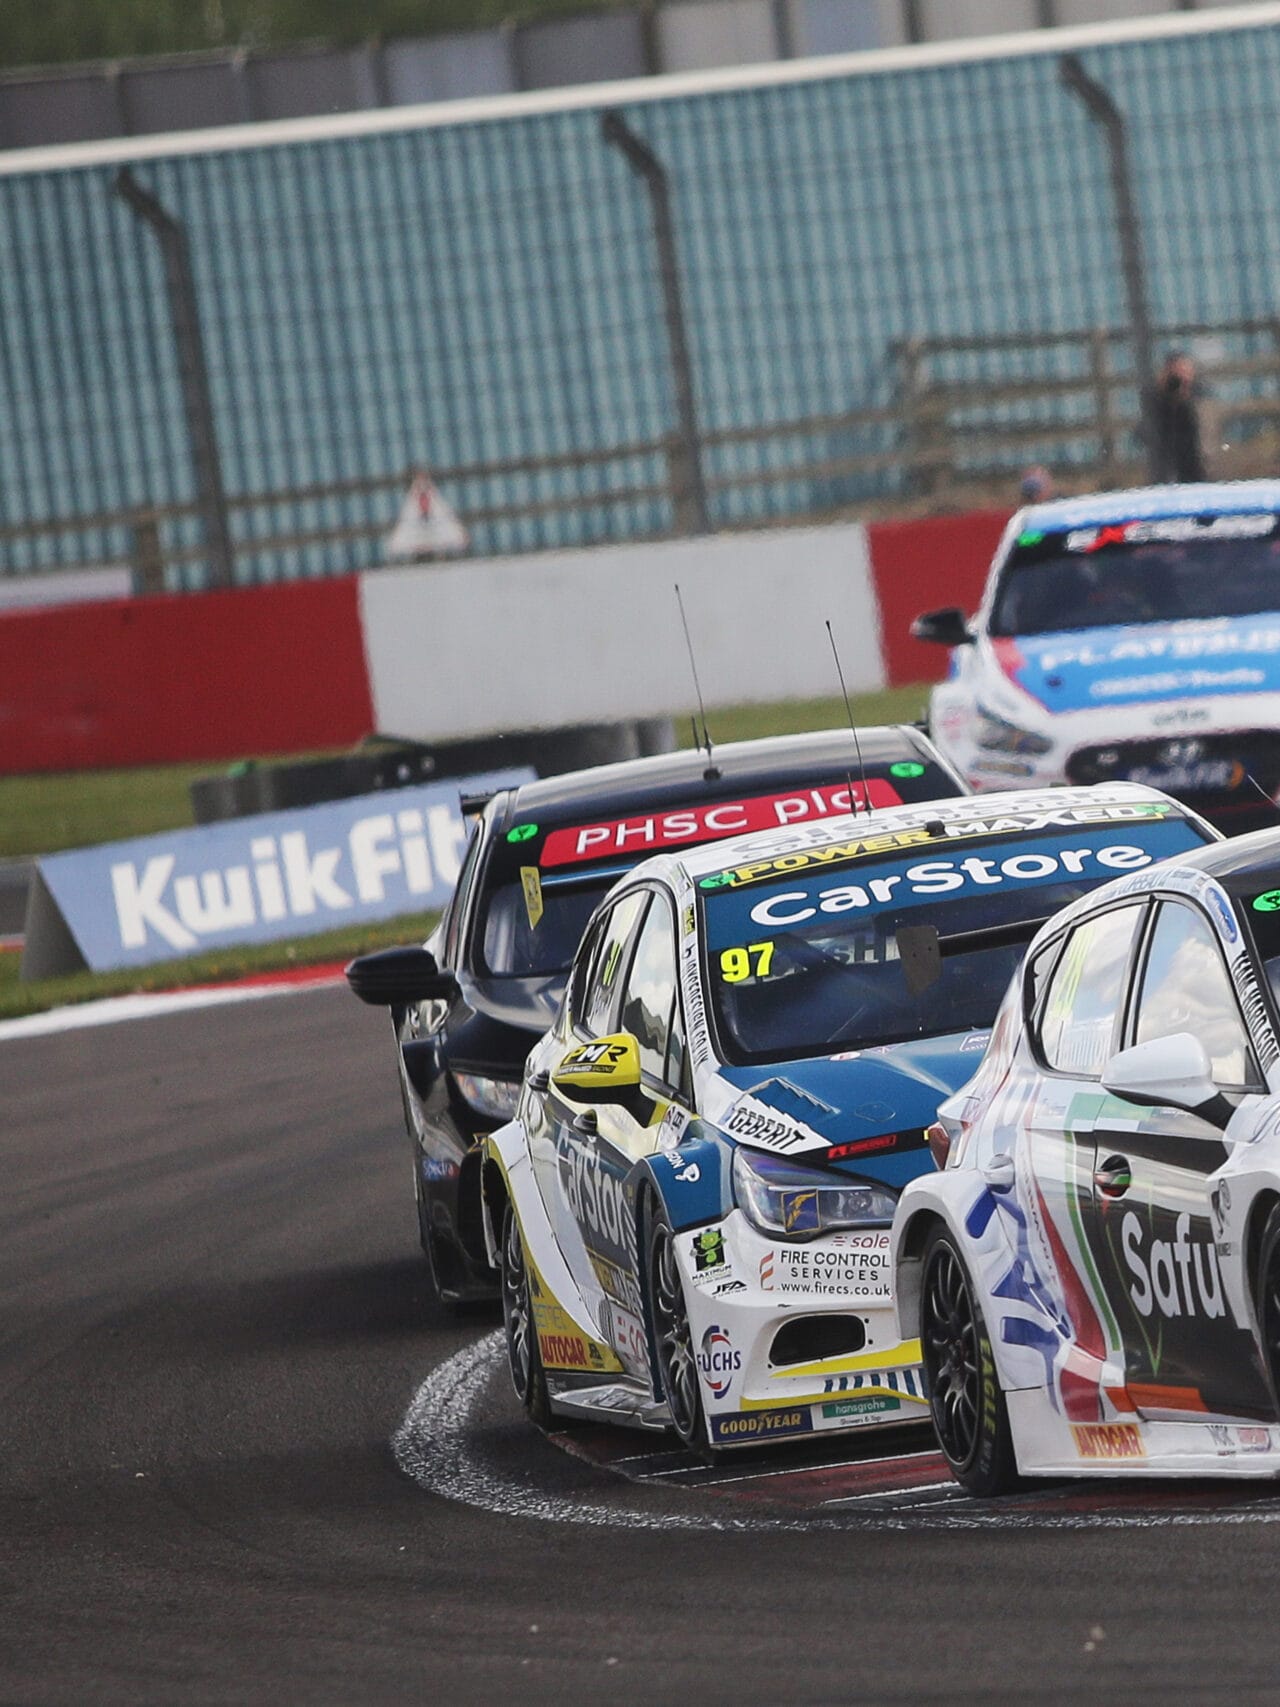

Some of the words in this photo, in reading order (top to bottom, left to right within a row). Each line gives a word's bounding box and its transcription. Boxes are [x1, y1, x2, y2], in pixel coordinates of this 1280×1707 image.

[576, 806, 747, 854] PHSC
[774, 790, 863, 823] plc
[735, 830, 931, 880] POWER
[945, 806, 1148, 837] MAXED
[751, 846, 1152, 926] CarStore
[720, 941, 775, 983] 97
[562, 1044, 628, 1065] PMR
[728, 1107, 806, 1151] GEBERIT
[780, 1250, 810, 1264] FIRE
[814, 1252, 890, 1268] CONTROL
[791, 1267, 879, 1281] SERVICES
[780, 1281, 891, 1296] www.firecs.co.uk
[697, 1350, 741, 1372] FUCHS
[835, 1399, 886, 1415] hansgrohe
[1073, 1425, 1144, 1456] AUTOCAR
